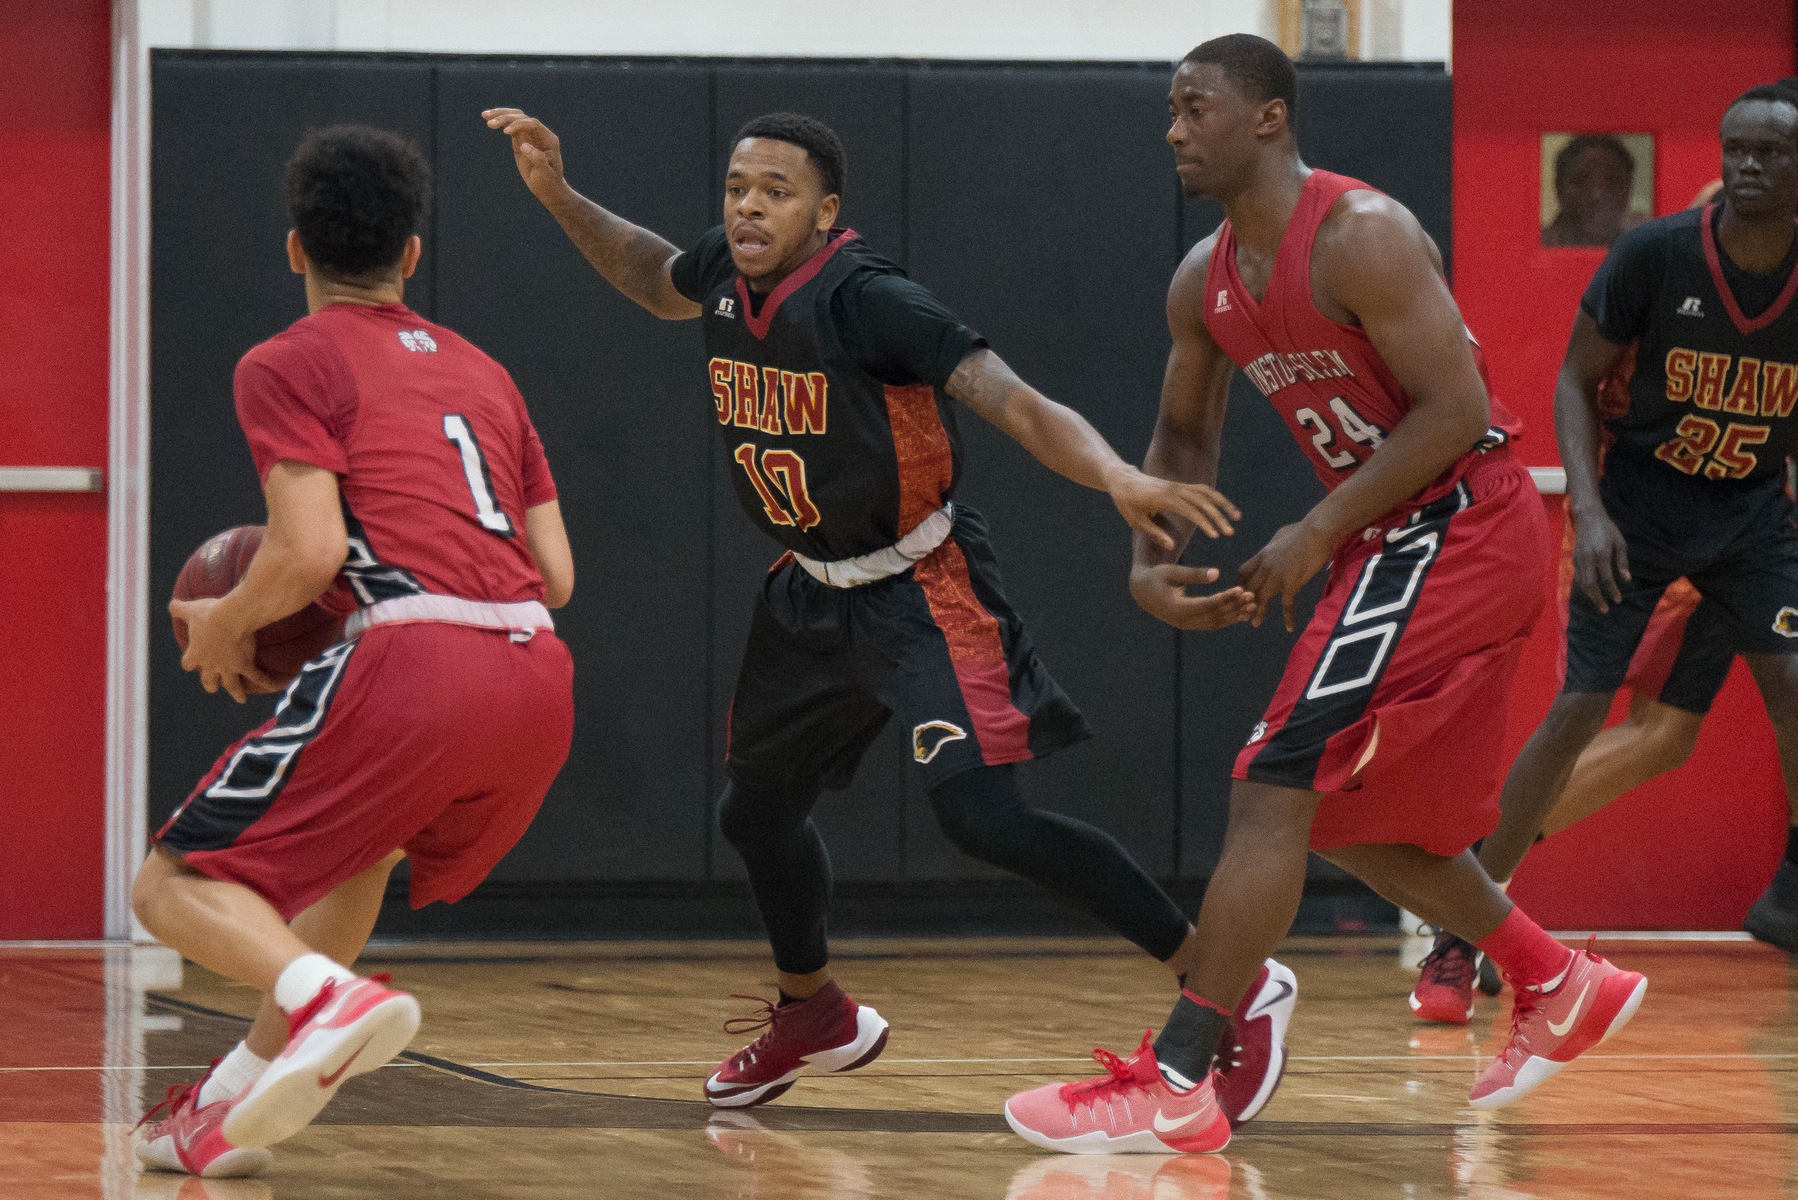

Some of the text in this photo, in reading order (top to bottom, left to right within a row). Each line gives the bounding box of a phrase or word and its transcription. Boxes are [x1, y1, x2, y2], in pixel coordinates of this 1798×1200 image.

[708, 357, 828, 435] SHAW
[1665, 346, 1798, 418] SHAW
[1296, 396, 1388, 471] 24
[1654, 413, 1771, 481] 25
[442, 413, 516, 538] 1
